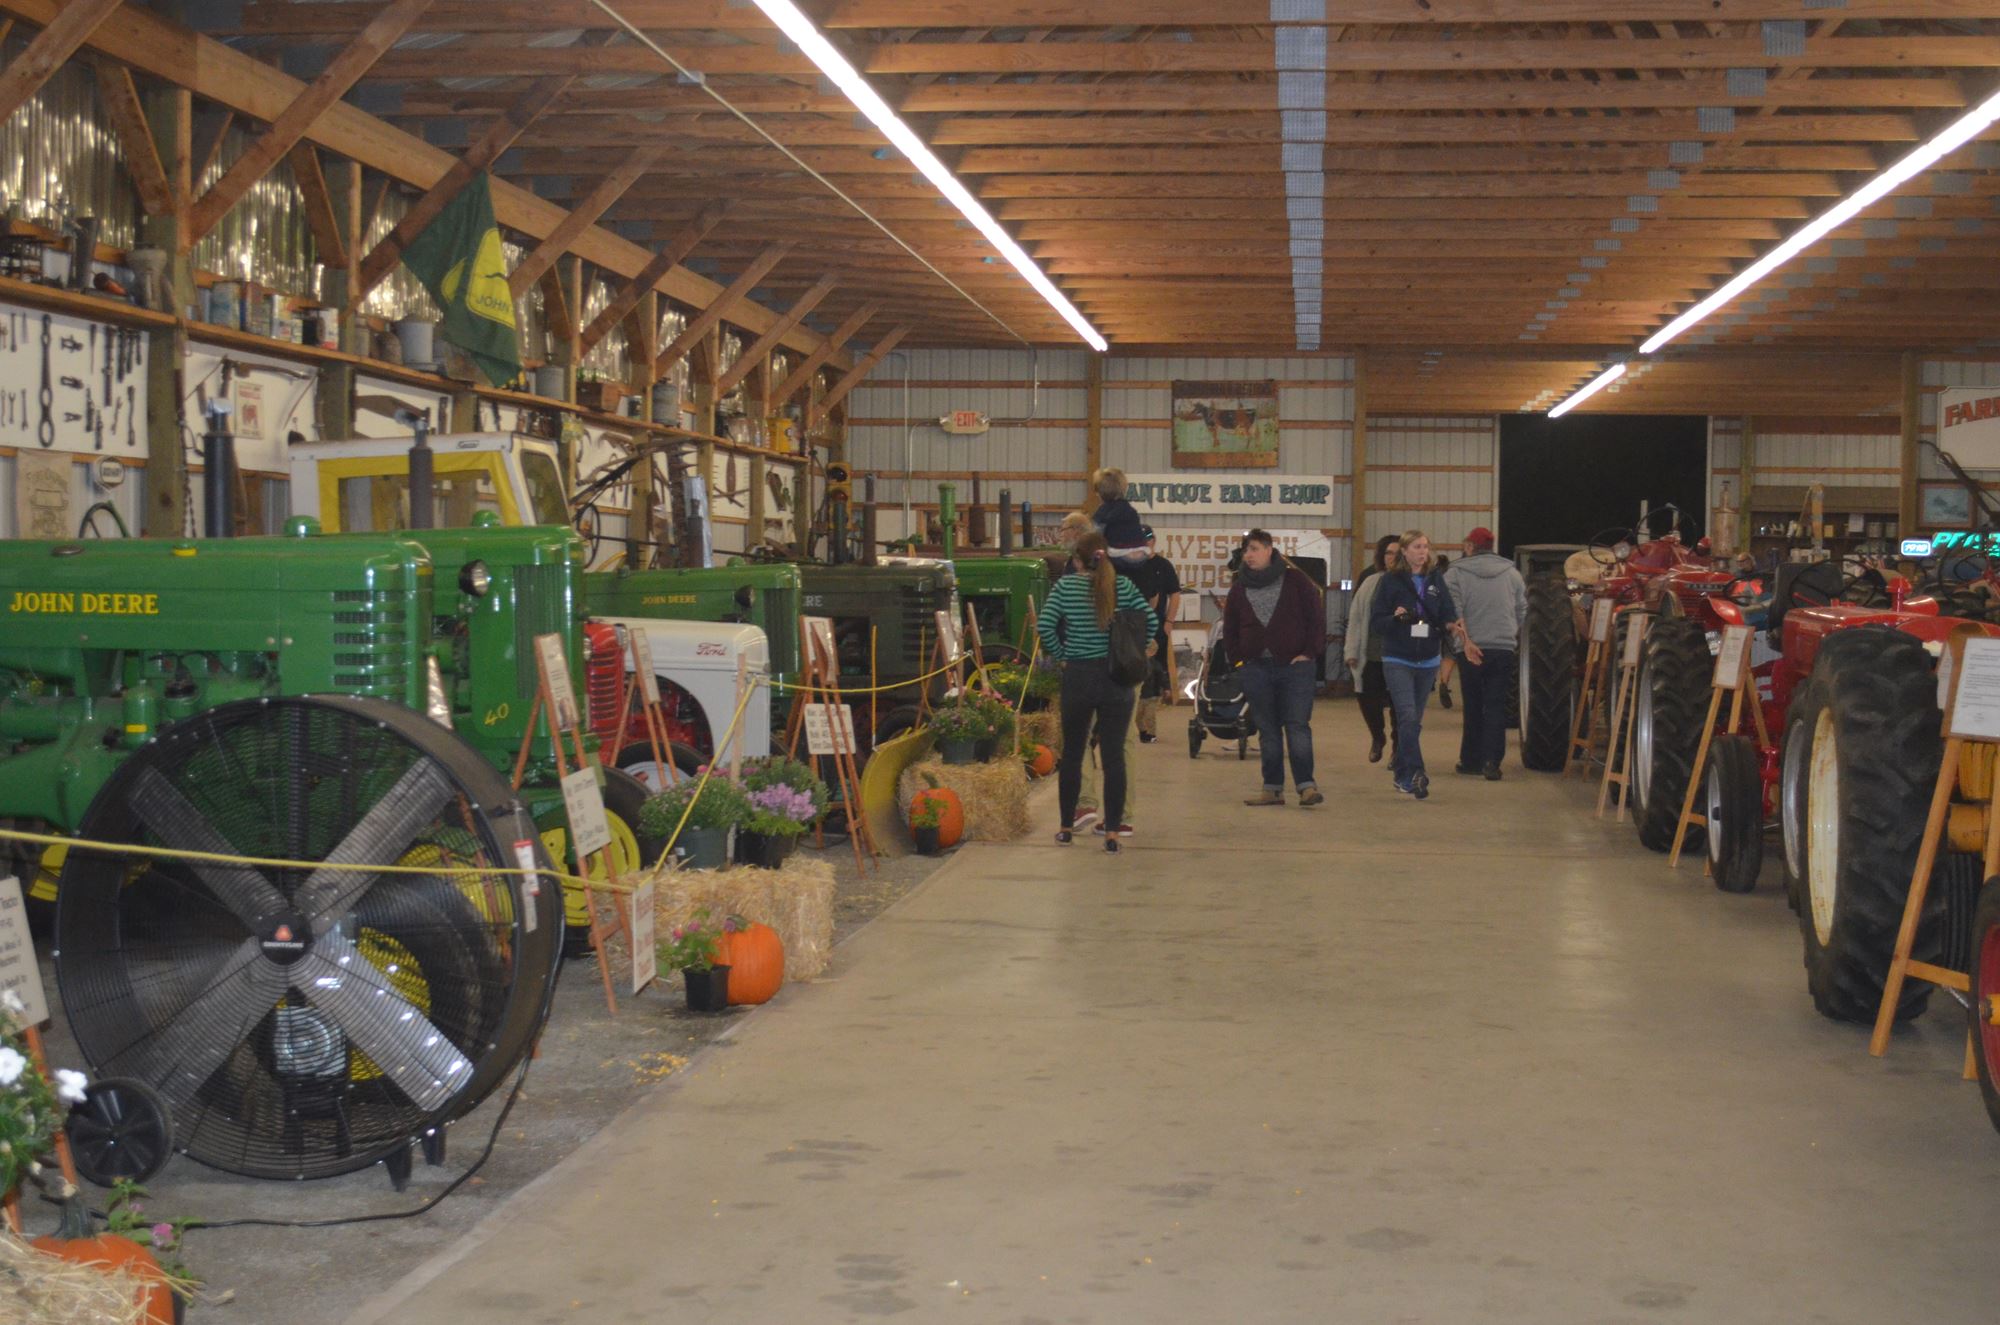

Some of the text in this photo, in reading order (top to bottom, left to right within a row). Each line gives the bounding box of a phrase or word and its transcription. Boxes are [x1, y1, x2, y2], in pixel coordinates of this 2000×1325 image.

[956, 412, 977, 428] EXIT
[1126, 482, 1330, 509] ANTIQUE FARM EQUIP
[11, 592, 160, 615] JOHN DEERE
[641, 594, 697, 605] JOHN DEERE
[696, 642, 727, 656] Ford
